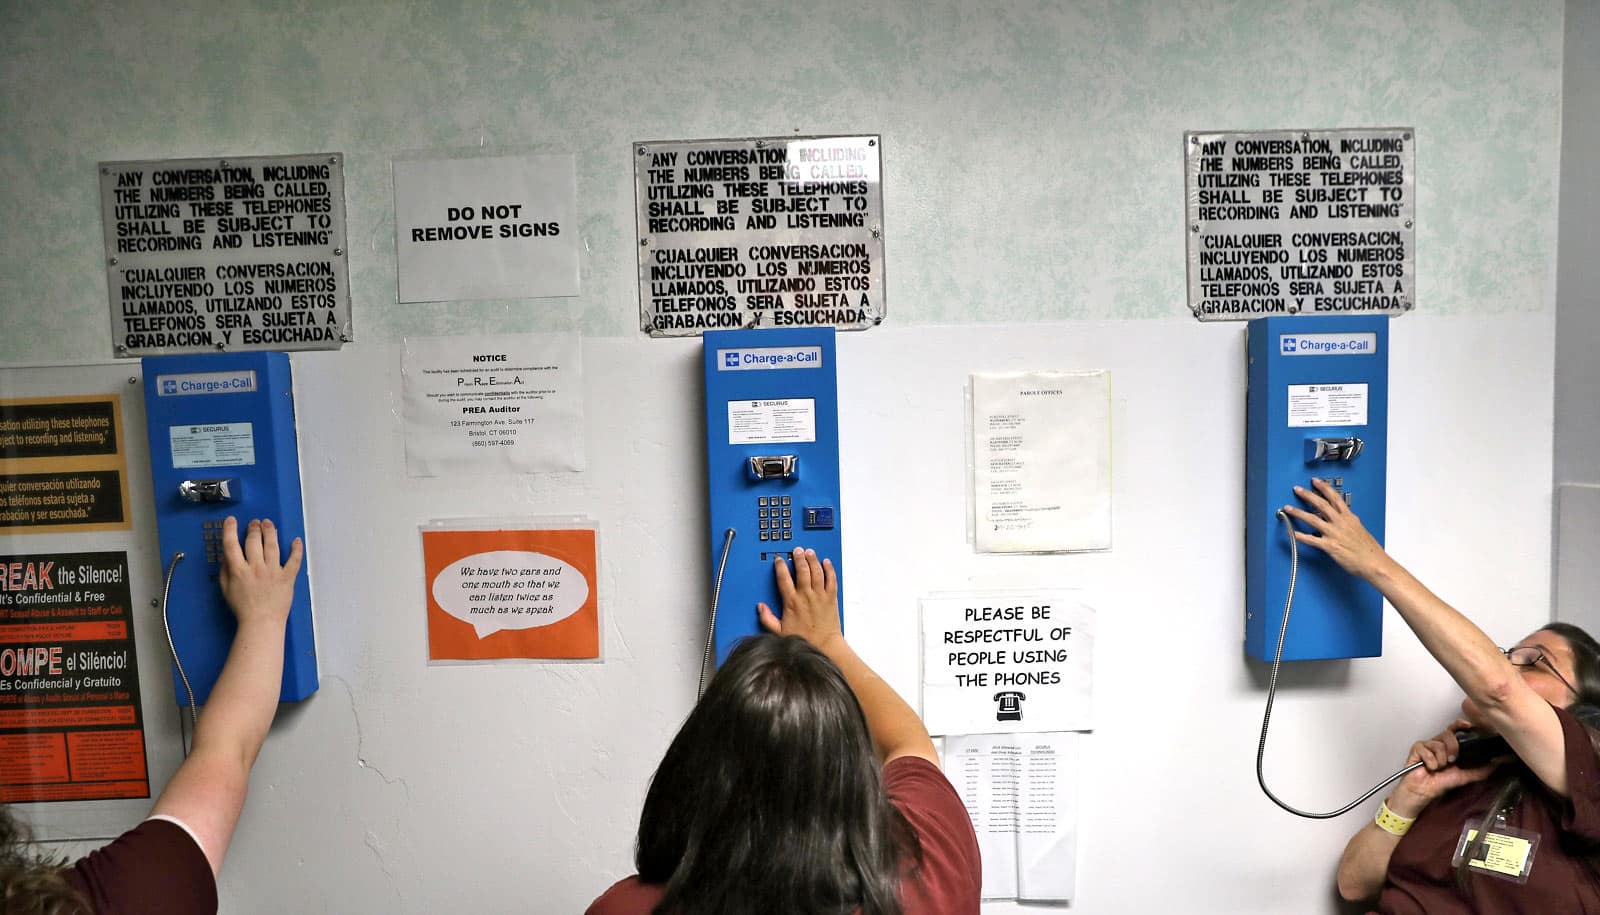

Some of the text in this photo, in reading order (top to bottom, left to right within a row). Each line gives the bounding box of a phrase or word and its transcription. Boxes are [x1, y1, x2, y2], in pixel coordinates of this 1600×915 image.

[1236, 140, 1332, 158] CONVERSATION,
[1341, 139, 1403, 153] INCLUDING
[1200, 155, 1403, 171] THE NUMBERS BEING CALLED,
[153, 168, 255, 185] CONVERSATION,
[264, 165, 329, 181] INCLUDING
[1198, 171, 1403, 188] UTILIZING THESE TELEPHONES
[114, 182, 331, 204] THE NUMBERS BEING CALLED,
[1199, 187, 1402, 204] SHALL BE SUBJECT TO
[115, 199, 331, 220] UTILIZING THESE TELEPHONES
[448, 205, 521, 221] DO NOT
[1200, 204, 1404, 220] RECORDING AND LISTENING"
[117, 215, 331, 236] SHALL BE SUBJECT TO
[412, 222, 560, 242] REMOVE SIGNS
[118, 231, 333, 253] RECORDING AND LISTENING"
[650, 244, 869, 264] "CUALQUIER CONVERSACION,
[120, 262, 335, 283] "CUALQUIER CONVERSACION,
[652, 260, 871, 280] INCLUYENDO LOS NUMEROS
[121, 278, 336, 299] INCLUYENDO LOS NUMEROS
[652, 277, 870, 297] LLAMADOS, UTILIZANDO ESTOS
[123, 295, 336, 316] LLAMADOS, UTILIZANDO ESTOS
[124, 311, 336, 332] TELEFONOS SERA SUJETA A
[125, 332, 212, 348] GRABACION
[223, 331, 231, 344] Y
[22, 418, 49, 431] utilizing
[52, 417, 70, 428] these
[72, 416, 109, 430] telephones
[462, 419, 492, 427] Farmington
[17, 434, 24, 444] to
[26, 431, 58, 446] recording
[60, 433, 72, 443] and
[18, 479, 64, 491] conversación
[66, 477, 100, 489] utilizando
[9, 494, 41, 506] teléfonos
[67, 494, 88, 506] sujeta
[32, 511, 35, 522] y
[37, 511, 48, 519] ser
[58, 566, 75, 584] the
[78, 564, 122, 584] Silence!
[460, 568, 474, 576] We
[477, 567, 499, 576] have
[501, 568, 517, 576] two
[543, 567, 562, 576] and
[482, 580, 510, 588] mouth
[527, 580, 545, 588] that
[16, 592, 72, 604] Confidential
[75, 592, 81, 602] &
[84, 592, 104, 601] Free
[489, 593, 513, 602] listen
[517, 593, 540, 601] twice
[471, 606, 494, 614] much
[526, 606, 553, 615] speak
[966, 606, 1050, 621] PLEASE BE
[944, 628, 1071, 644] RESPECTFUL OF
[0, 647, 126, 676] OMPE el Siléncio!
[949, 650, 1067, 665] PEOPLE USING
[0, 677, 121, 690] Es Confidencial y Gratuito
[956, 672, 1060, 687] THE PHONES
